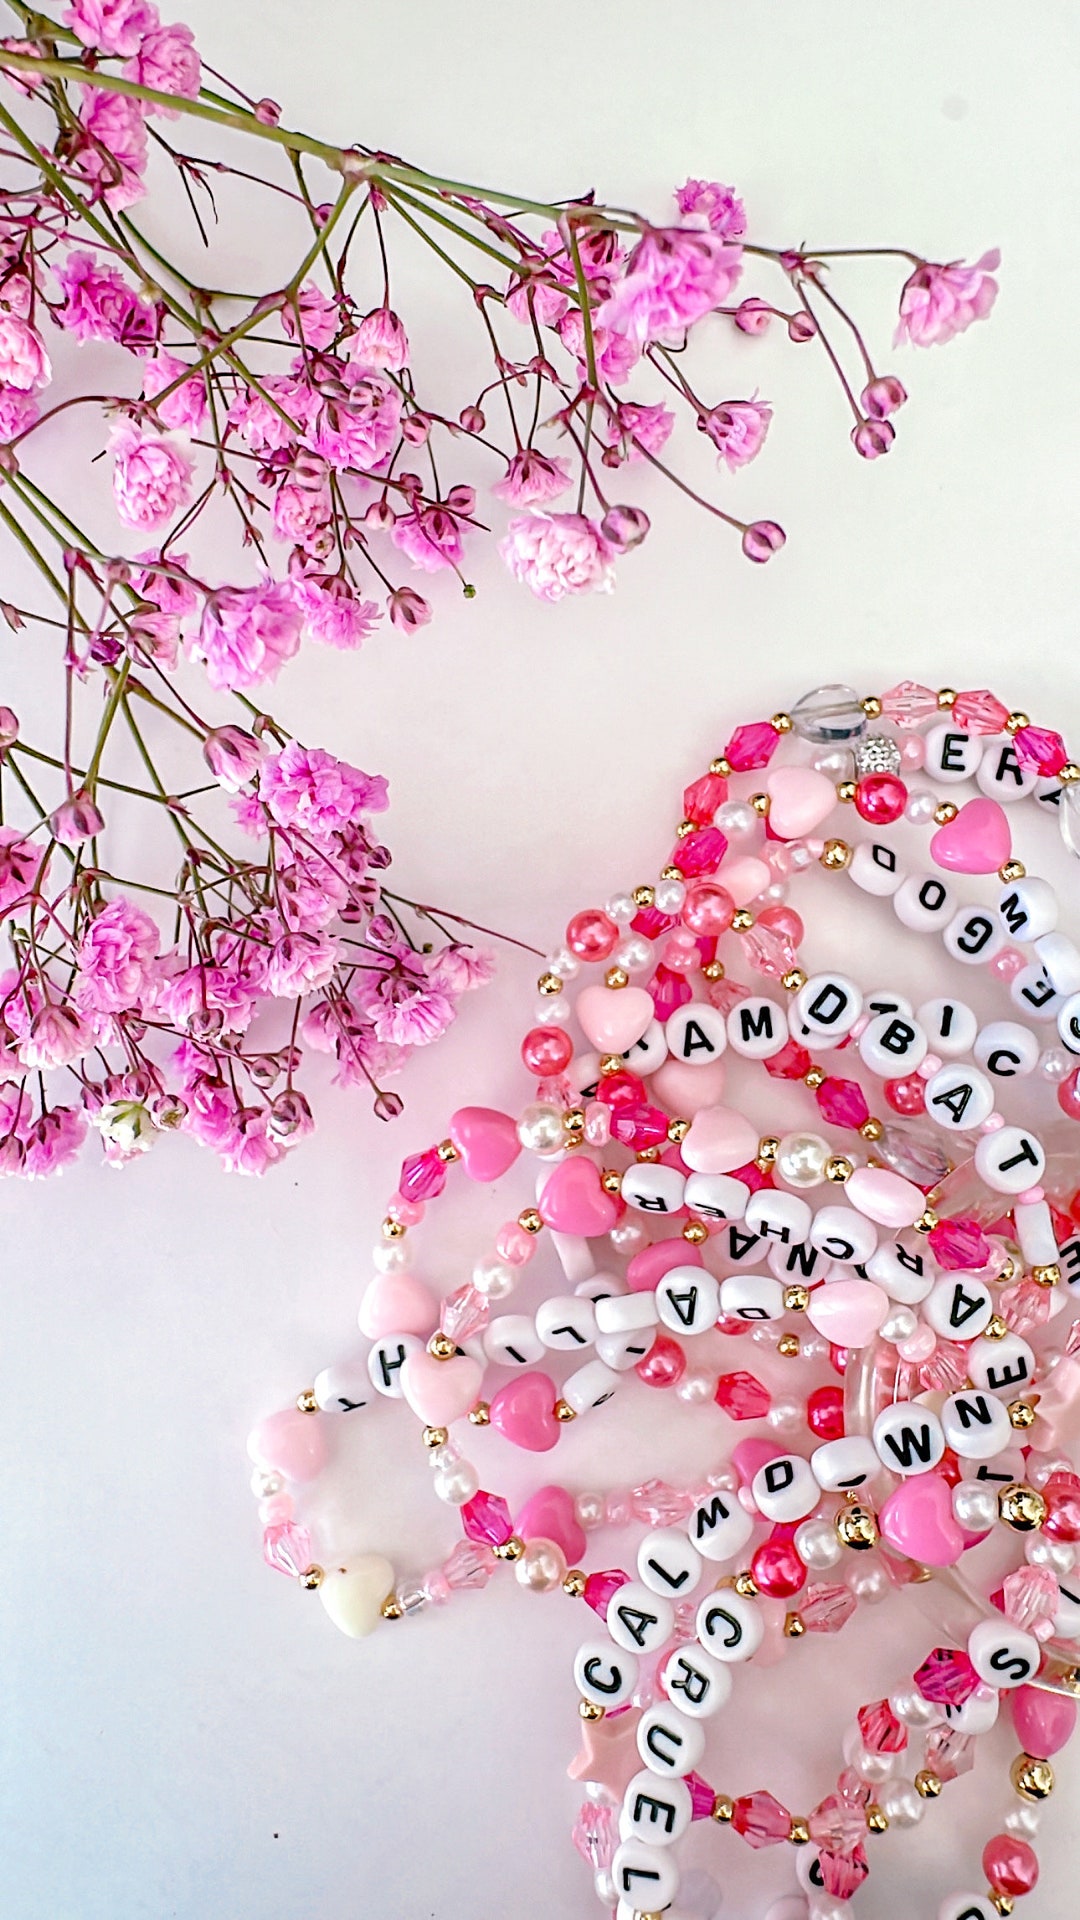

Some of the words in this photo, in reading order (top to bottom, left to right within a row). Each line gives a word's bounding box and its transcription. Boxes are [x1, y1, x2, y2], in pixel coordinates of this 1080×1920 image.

[583, 1496, 730, 1694] CALM
[764, 1395, 993, 1493] DWN
[622, 1607, 743, 1892] CRUEL
